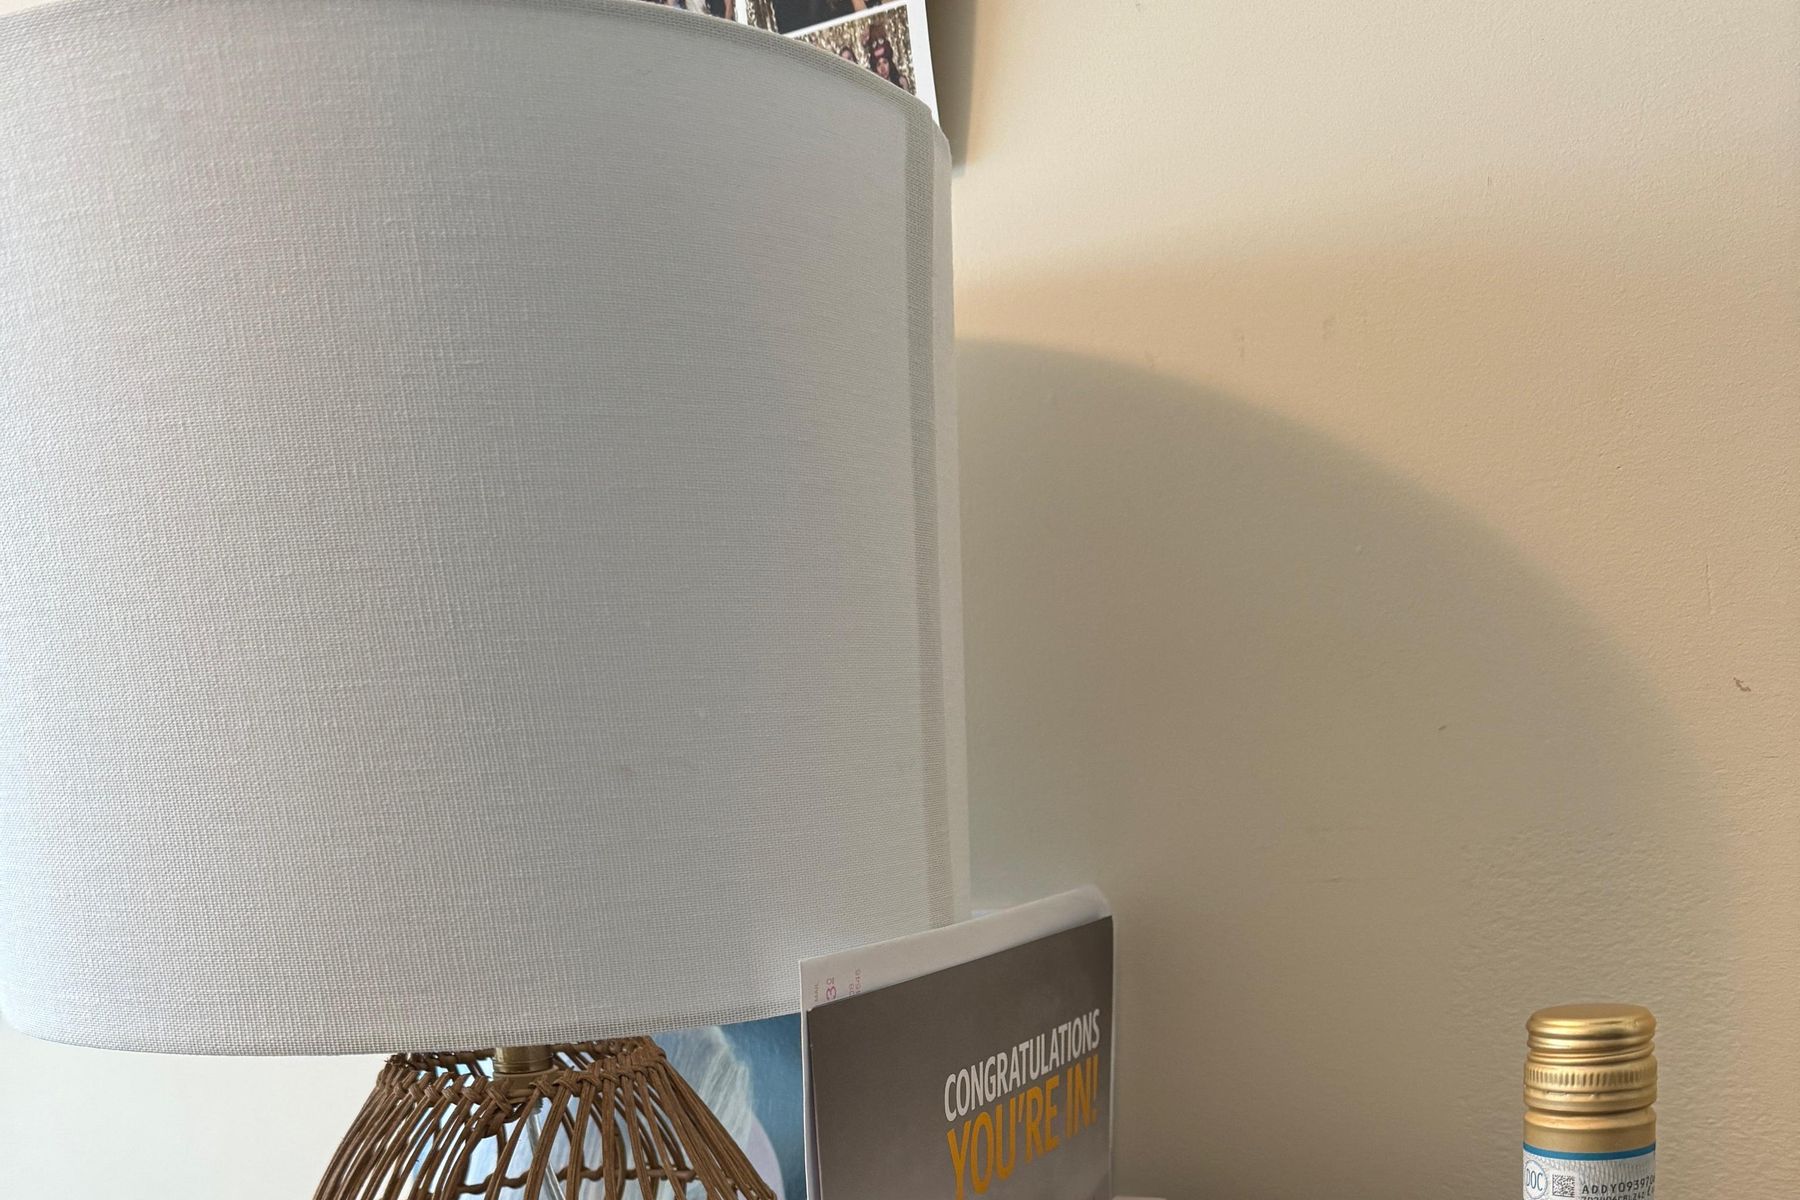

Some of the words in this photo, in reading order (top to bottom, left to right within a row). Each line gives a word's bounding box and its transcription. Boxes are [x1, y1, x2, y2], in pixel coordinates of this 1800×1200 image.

[943, 1008, 1100, 1122] CONGRATULATIONS
[1065, 1053, 1099, 1139] IN!
[1526, 1168, 1543, 1191] DOC
